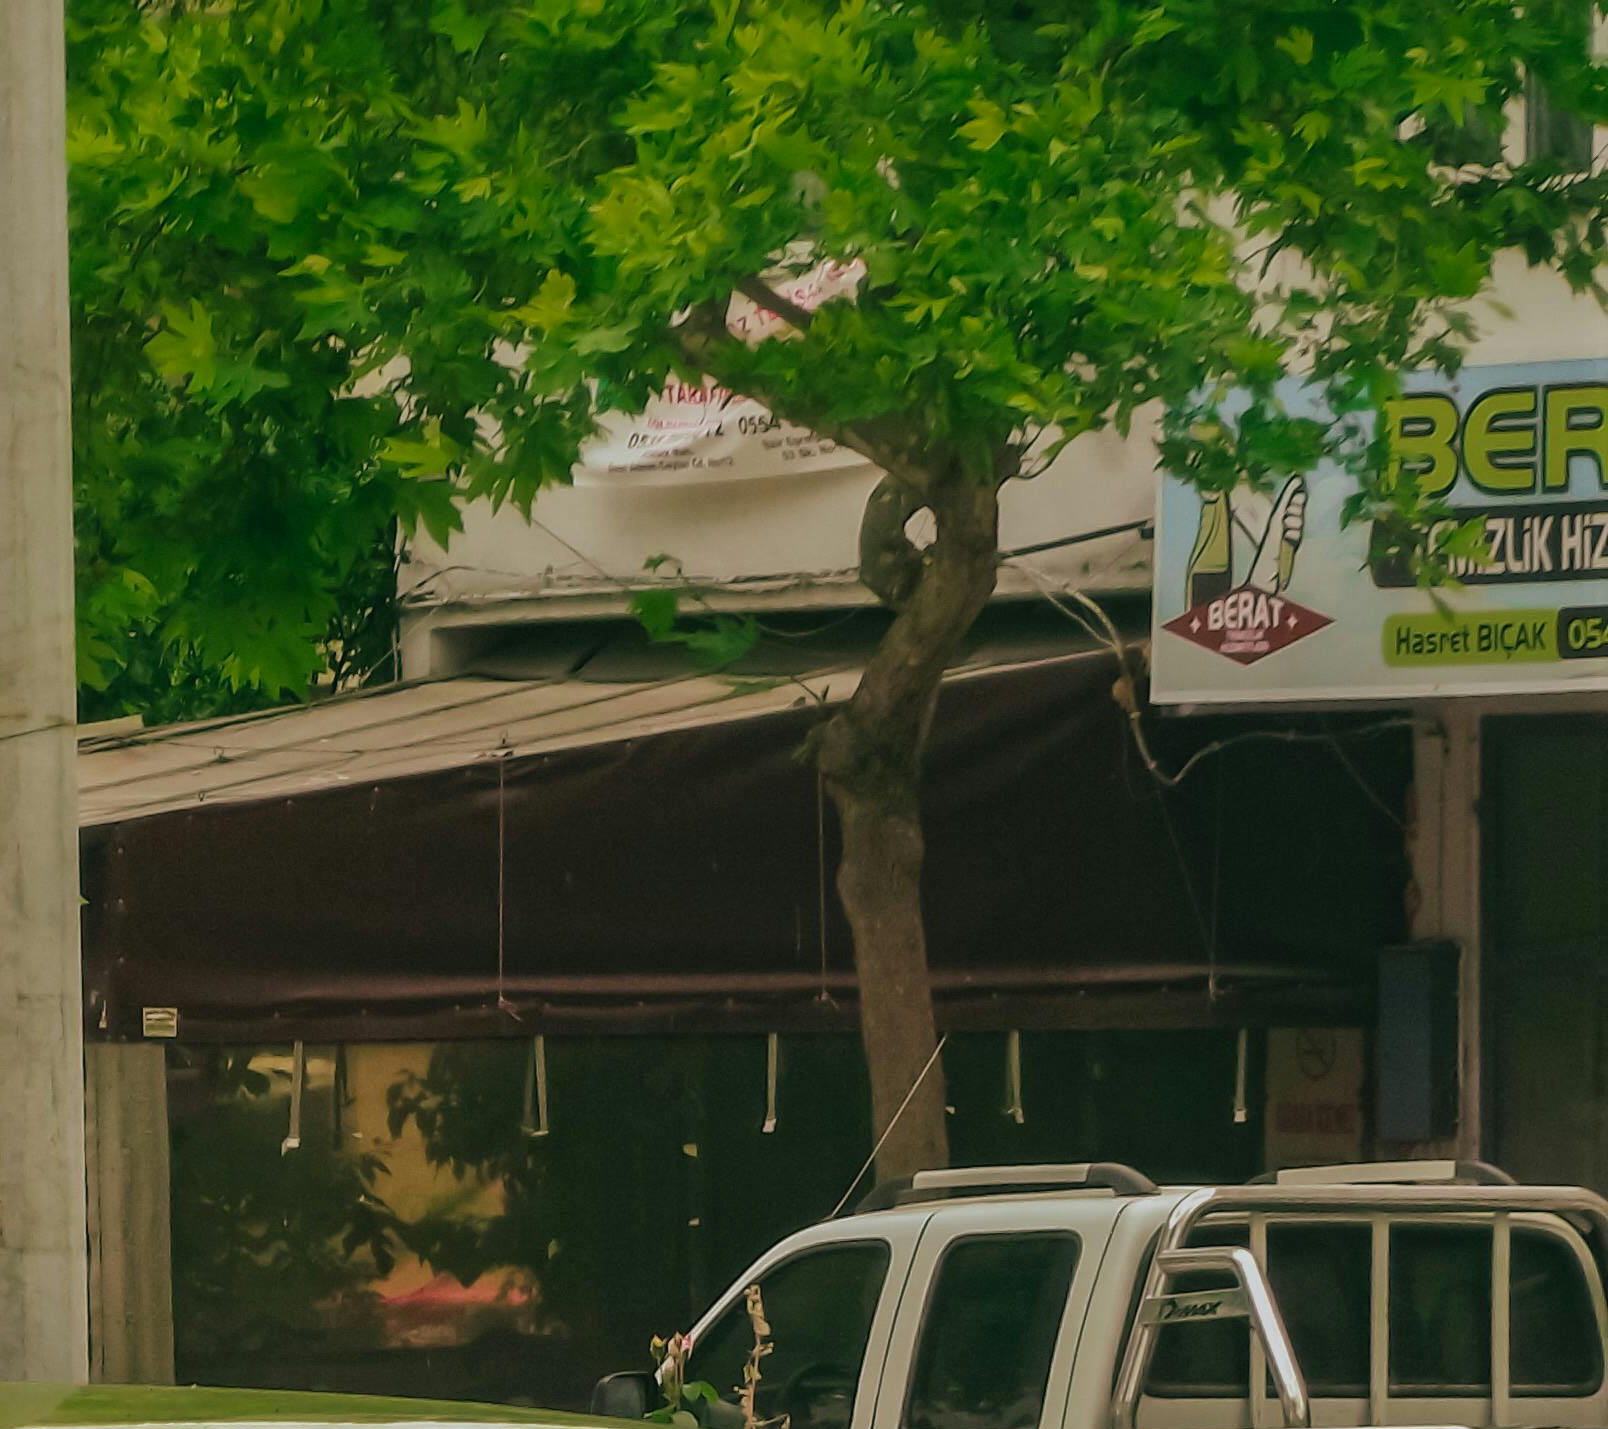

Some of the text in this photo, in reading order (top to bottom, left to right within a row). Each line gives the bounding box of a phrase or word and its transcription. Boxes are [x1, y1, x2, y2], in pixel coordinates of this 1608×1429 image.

[1207, 591, 1285, 632] BERAT
[1395, 616, 1608, 660] Hasret BIÇAK 05
